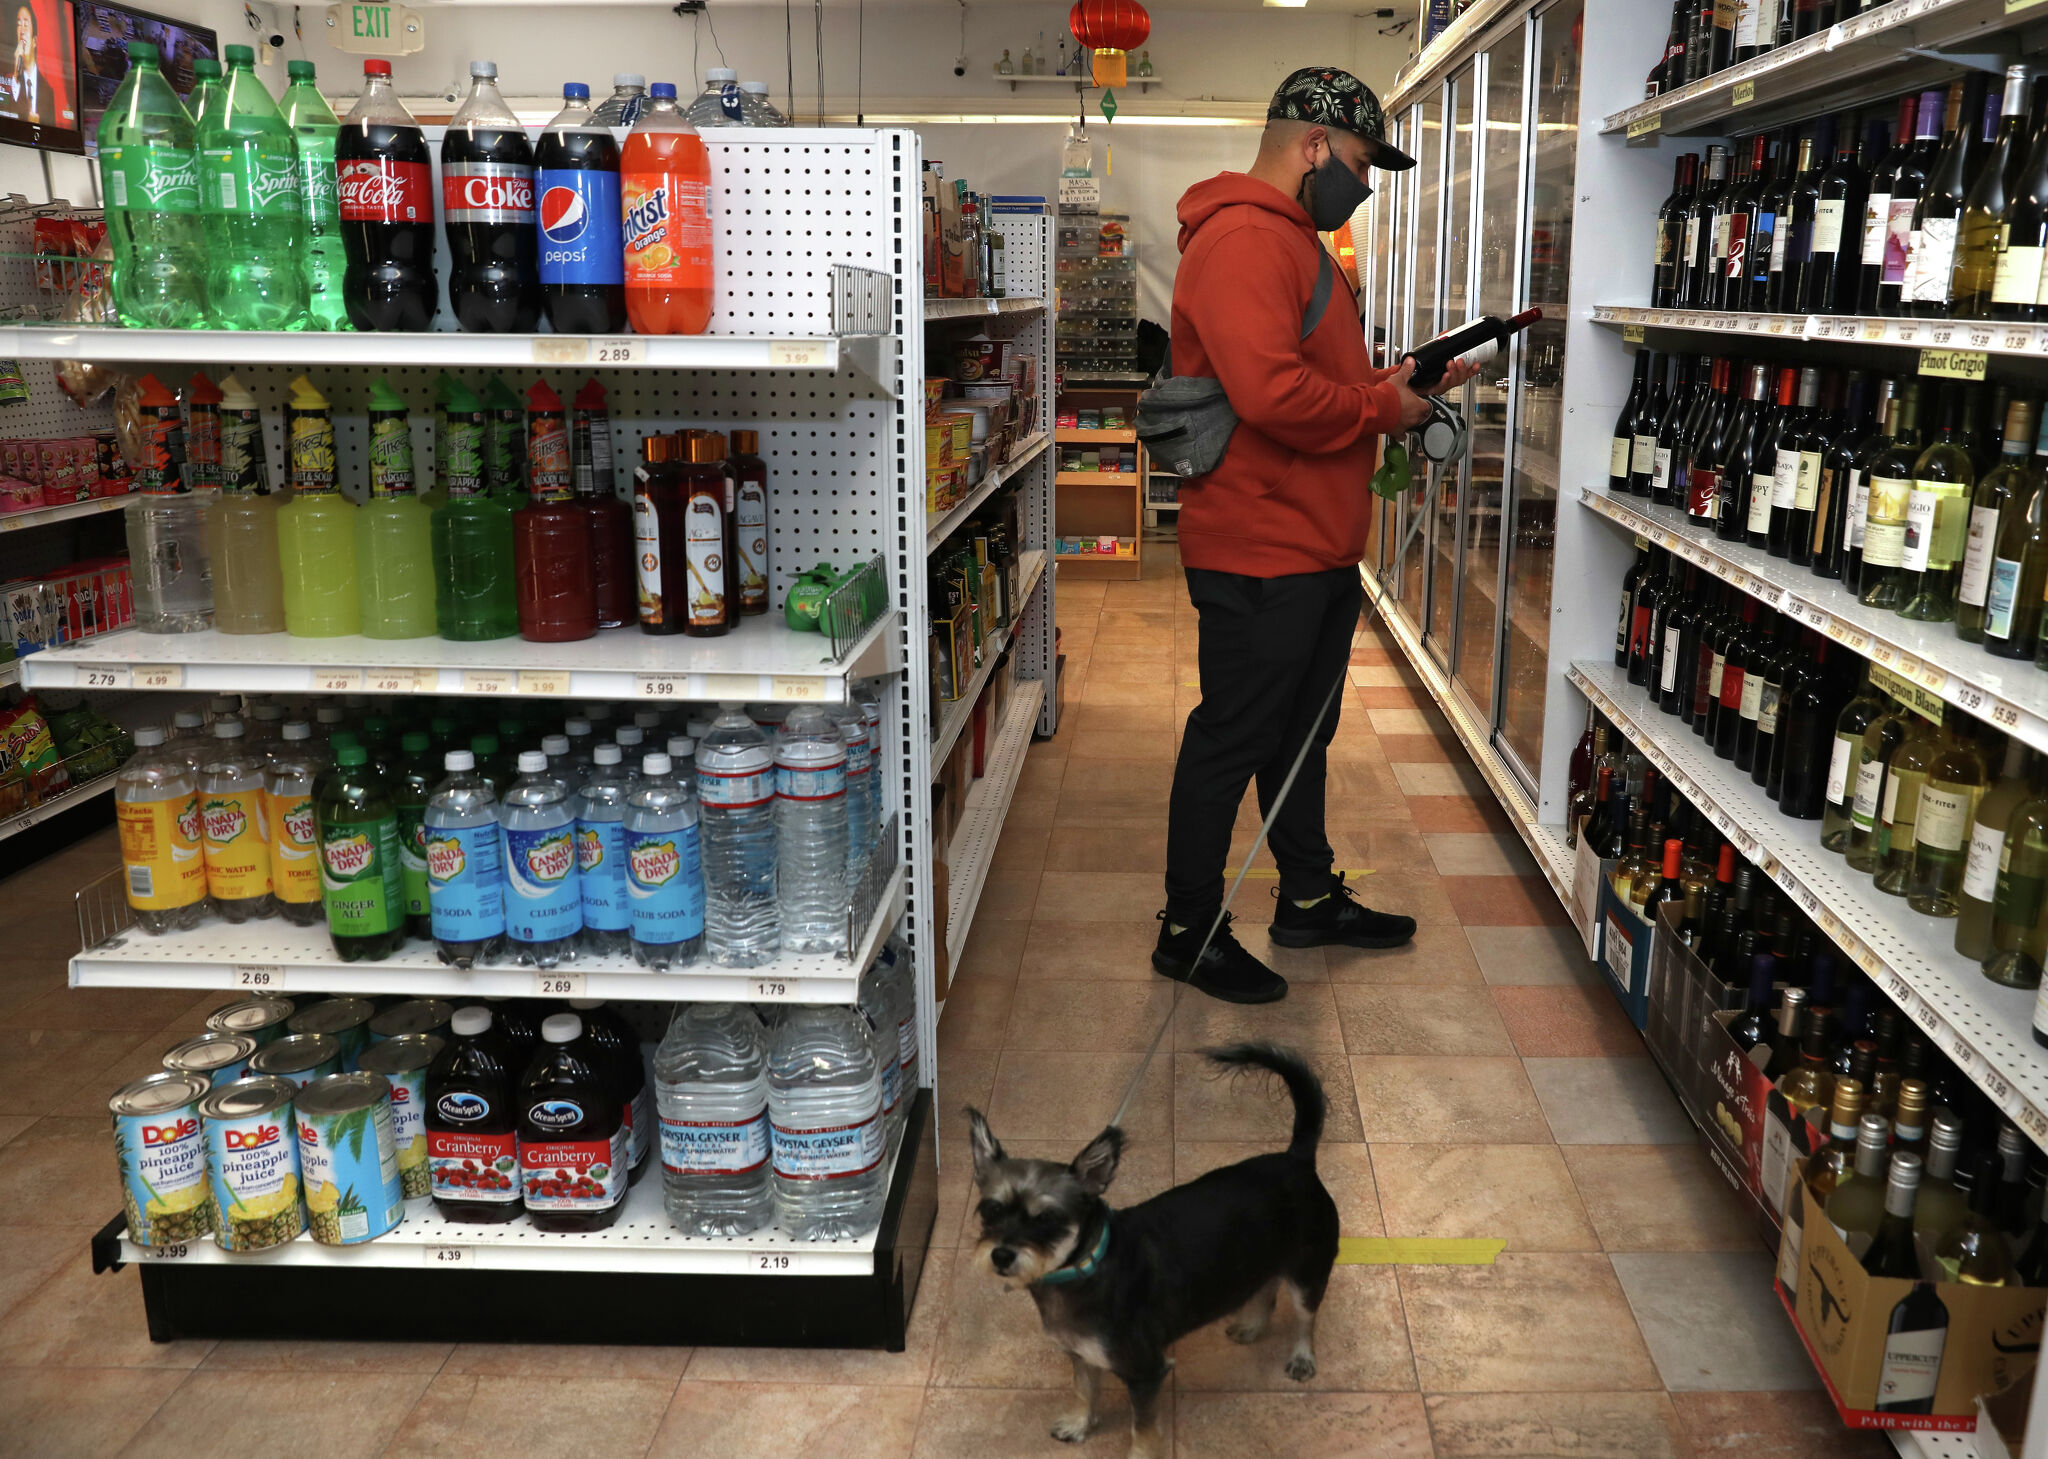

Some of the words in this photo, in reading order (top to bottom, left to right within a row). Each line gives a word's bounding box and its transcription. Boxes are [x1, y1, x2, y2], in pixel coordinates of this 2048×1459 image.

[352, 5, 392, 39] EXIT
[146, 168, 198, 189] Sprite
[257, 171, 299, 192] Sprite
[512, 178, 529, 190] Diet
[301, 180, 330, 197] rite
[464, 178, 533, 209] Coke
[623, 187, 670, 248] nkist
[634, 227, 667, 251] Orange
[545, 246, 588, 264] pepsi
[599, 349, 630, 362] 2.89
[1919, 351, 1948, 370] Pinot
[1949, 352, 1985, 377] Grigio
[1776, 462, 1794, 471] LAYA
[458, 477, 481, 489] APPLE
[740, 514, 764, 523] AGAVE
[88, 673, 116, 686] 2.79
[146, 676, 168, 686] 4.99
[326, 680, 348, 689] 4.99
[378, 680, 399, 690] 4.99
[532, 683, 555, 693] 3.99
[645, 683, 674, 695] 5.99
[1869, 664, 1914, 703] Sauvignon
[1914, 688, 1943, 719] Blanc
[1958, 688, 1982, 710] 10.99
[1992, 704, 2019, 727] 15.99
[212, 822, 235, 838] DRY
[324, 841, 375, 866] CANADA
[1973, 838, 1993, 854] LAYA
[337, 856, 364, 872] DRY
[427, 847, 466, 865] ANADA
[528, 841, 575, 873] CANADA
[631, 849, 681, 875] CANADA
[225, 865, 257, 875] WATER
[433, 860, 455, 875] DRY
[546, 858, 569, 876] DRY
[644, 863, 670, 880] DRY
[1780, 872, 1796, 891] 10.99
[333, 900, 375, 911] GINGER
[1800, 892, 1818, 912] 11.99
[342, 909, 365, 920] ALE
[444, 908, 472, 918] SODA
[529, 908, 558, 919] CLUB
[632, 909, 656, 919] CLUB
[657, 910, 686, 921] SODA
[242, 972, 270, 985] 2.69
[543, 980, 572, 993] 2.69
[758, 984, 786, 996] 1.79
[1888, 979, 1909, 1002] 17.99
[1918, 1008, 1937, 1031] 15.99
[1984, 1072, 2008, 1098] 13.99
[442, 1101, 463, 1114] Ocean
[463, 1101, 483, 1116] Spray
[534, 1110, 554, 1123] Ocean
[555, 1111, 576, 1125] Spray
[2019, 1106, 2047, 1137] 10.99
[141, 1118, 198, 1144] Dole
[224, 1125, 281, 1150] Dole
[660, 1127, 697, 1142] CRYSTAL
[698, 1132, 741, 1142] GEYSER
[159, 1142, 190, 1157] 100%
[436, 1138, 502, 1159] Cranberry
[774, 1134, 810, 1149] CRYSTAL
[811, 1135, 855, 1149] GEYSER
[222, 1150, 290, 1175] pineapple
[240, 1149, 271, 1162] 100%
[527, 1150, 596, 1167] Cranberry
[826, 1151, 851, 1159] WATER
[158, 1160, 195, 1180] juice
[239, 1166, 276, 1185] juice
[1710, 1148, 1722, 1168] RED
[1721, 1164, 1740, 1191] BLEND
[156, 1244, 188, 1258] 3.99
[437, 1250, 462, 1262] 4.39
[760, 1257, 790, 1269] 2.19
[1887, 1351, 1939, 1365] UPPERCUT
[1860, 1416, 1896, 1428] PAIR
[1901, 1418, 1934, 1429] with
[1938, 1418, 1961, 1430] the
